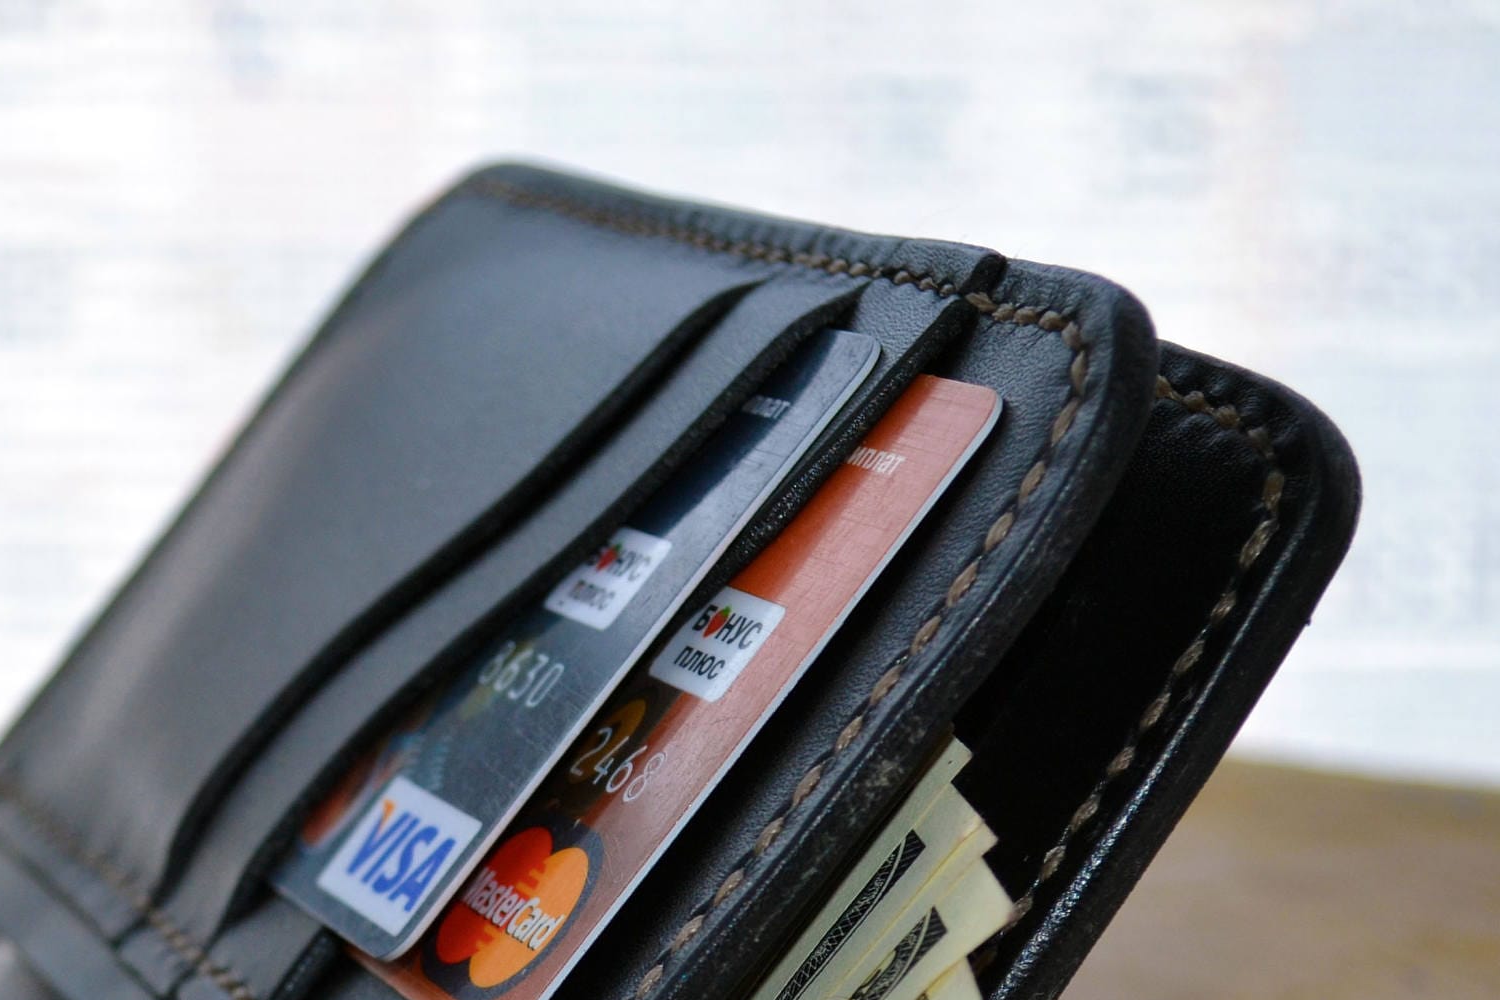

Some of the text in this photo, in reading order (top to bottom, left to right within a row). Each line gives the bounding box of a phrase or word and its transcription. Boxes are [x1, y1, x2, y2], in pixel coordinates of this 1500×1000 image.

[569, 726, 667, 802] 2468
[346, 799, 457, 913] VISA
[462, 867, 565, 951] MasterCard
